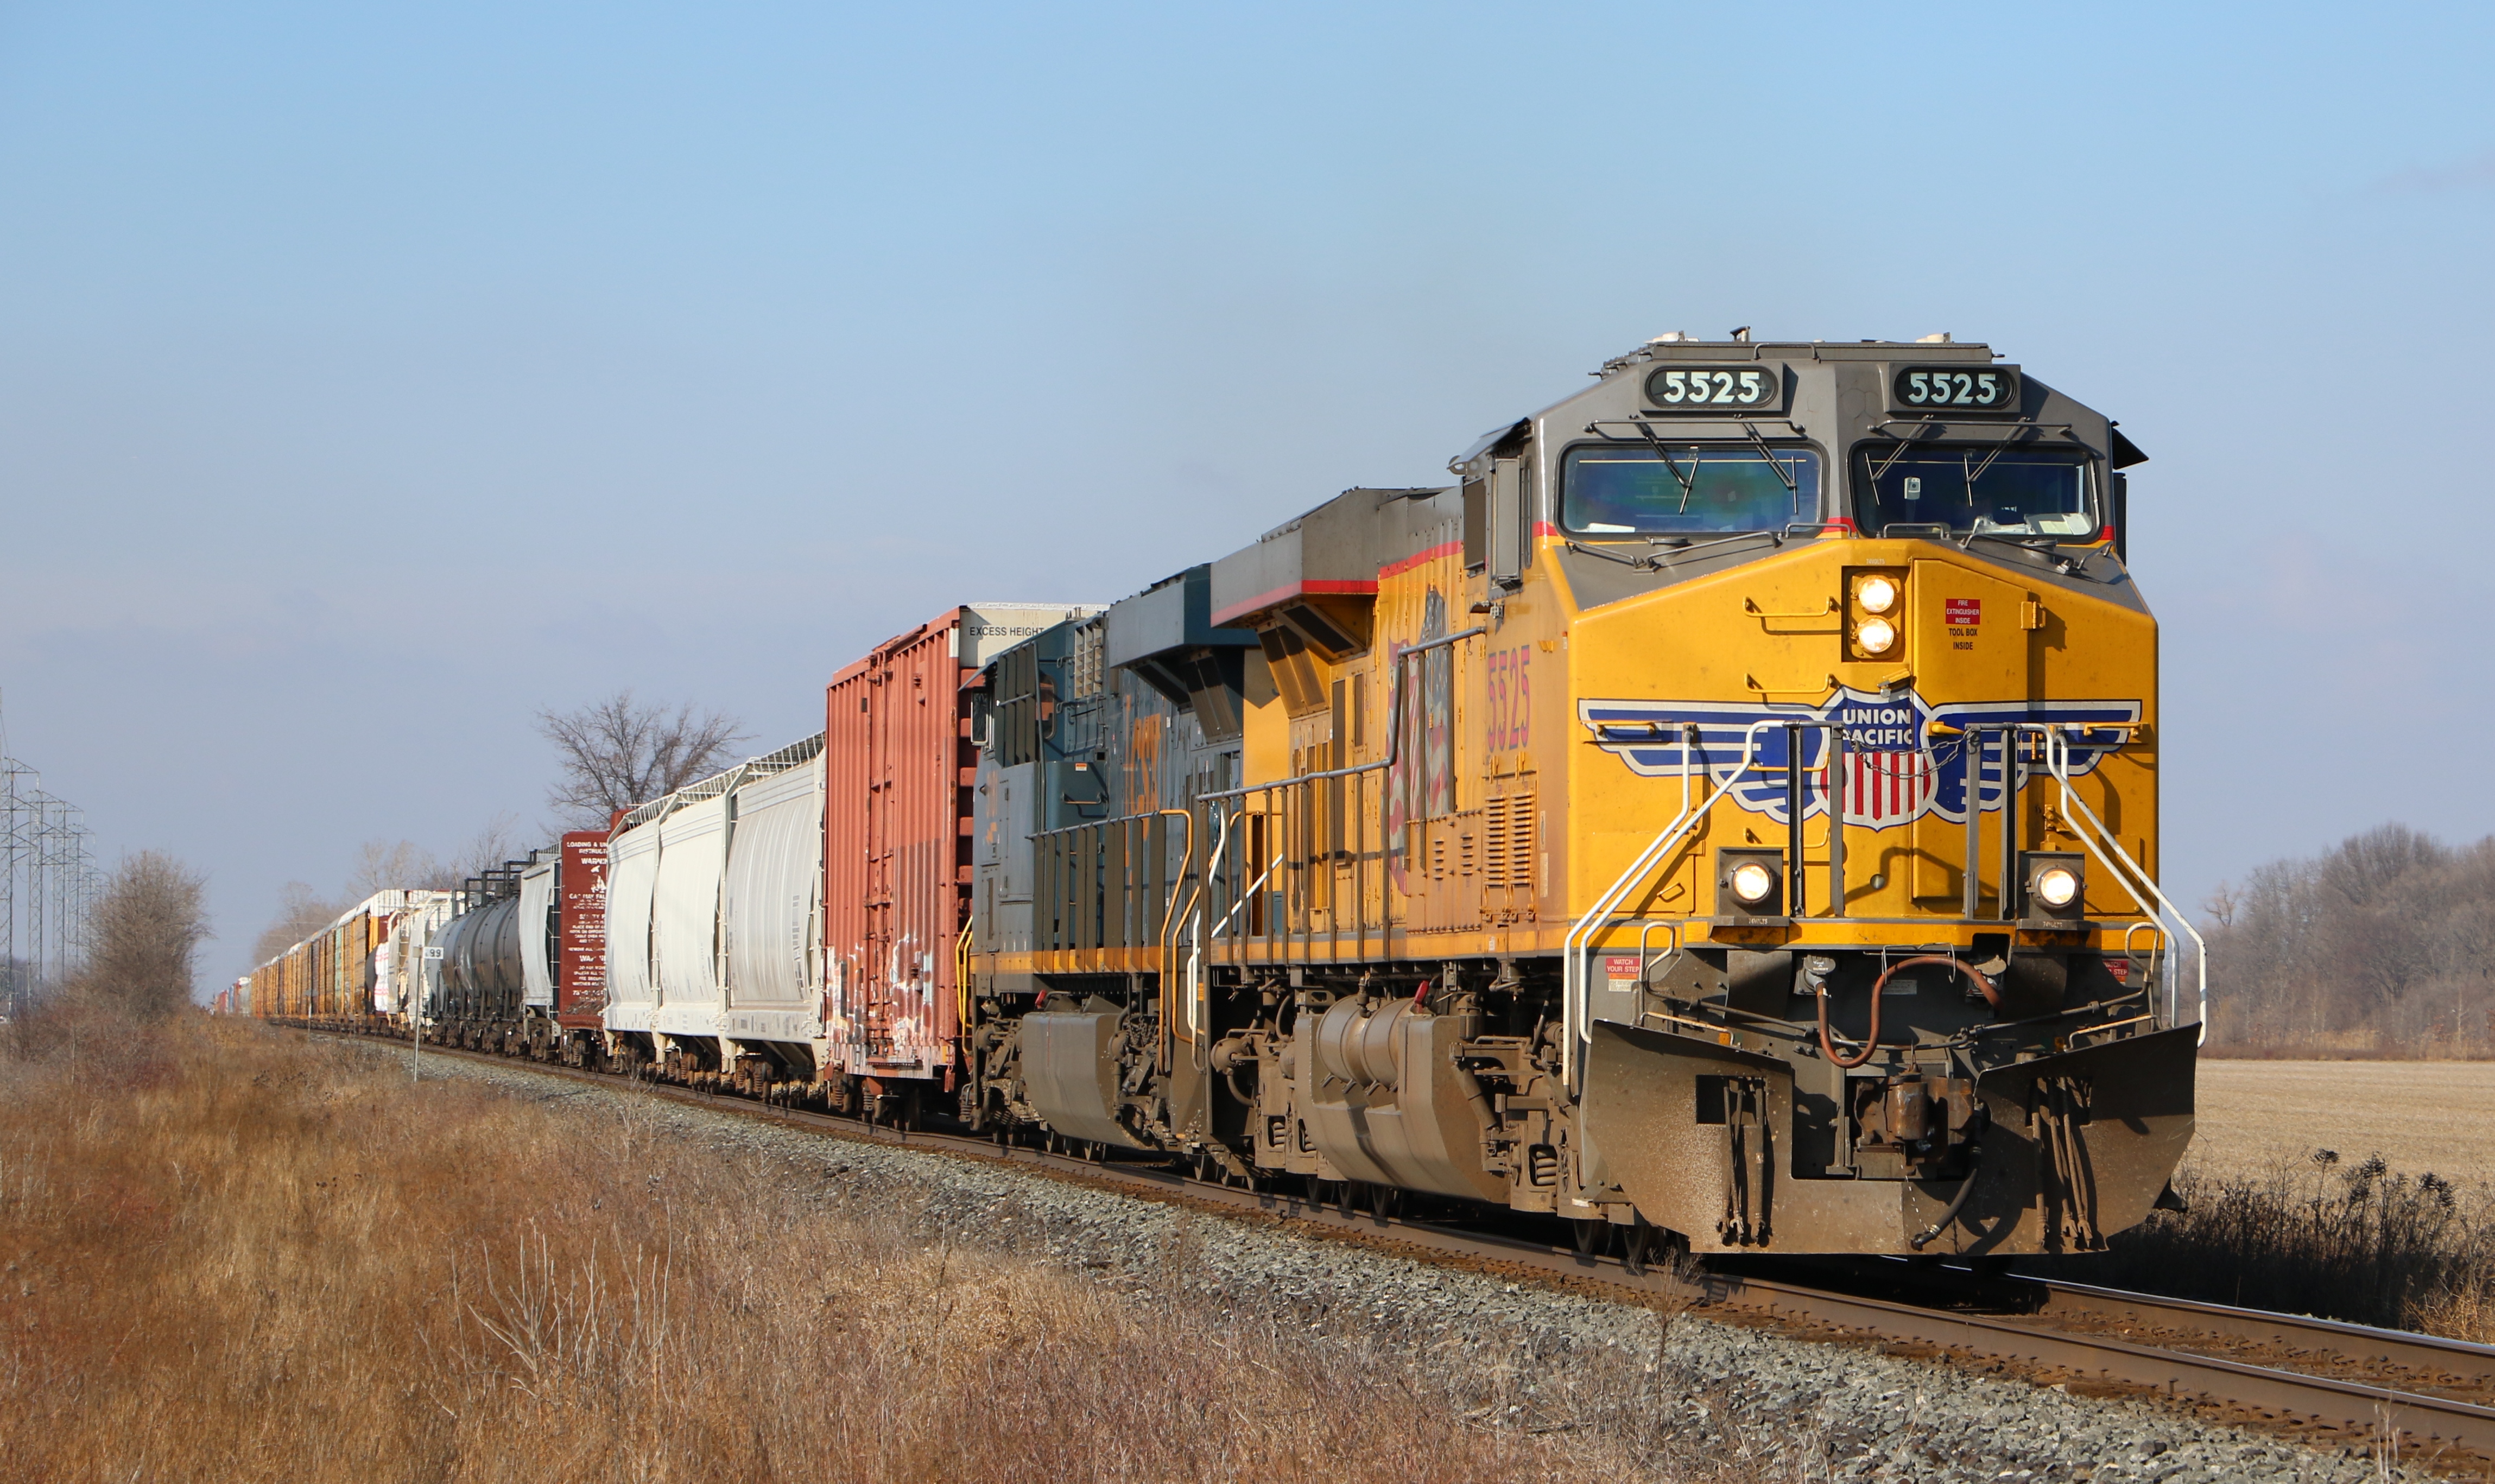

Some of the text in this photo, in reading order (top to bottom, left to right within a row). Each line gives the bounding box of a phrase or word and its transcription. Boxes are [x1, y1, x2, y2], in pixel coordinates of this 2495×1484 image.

[1663, 371, 1759, 403] 5525
[1908, 372, 1996, 404] 5525
[970, 627, 1007, 636] EXCESS
[1948, 628, 1978, 636] TOOL BOX
[1953, 642, 1973, 650] INSIDE
[1487, 645, 1530, 753] 5525
[1842, 708, 1911, 725] UNION
[1130, 713, 1161, 840] CSX
